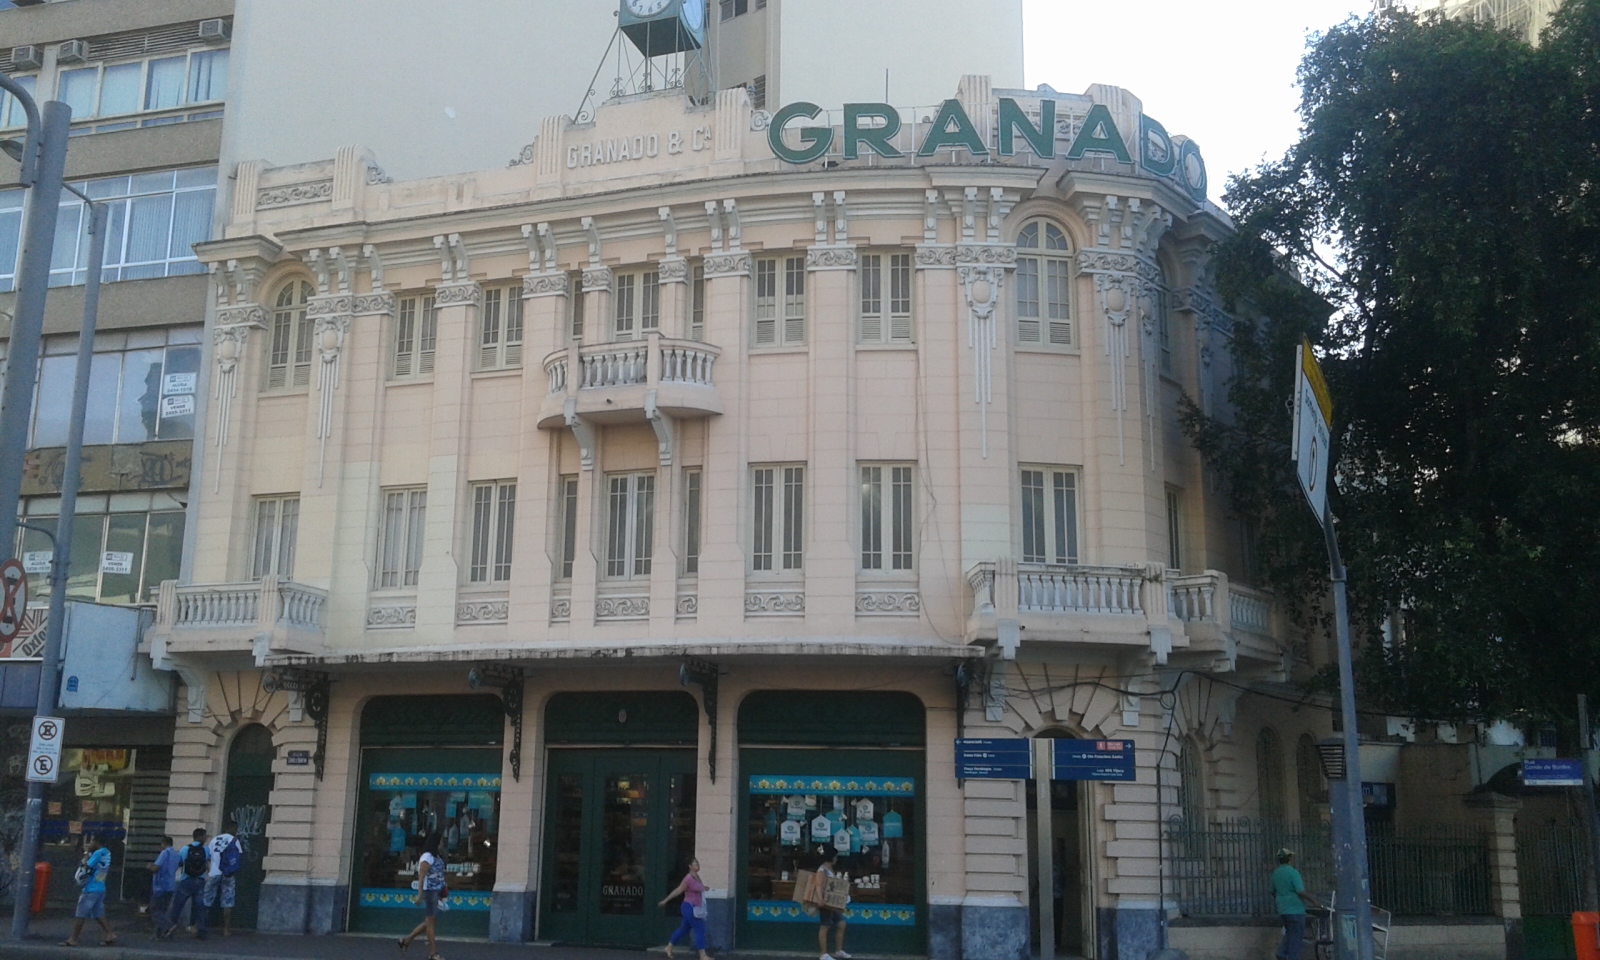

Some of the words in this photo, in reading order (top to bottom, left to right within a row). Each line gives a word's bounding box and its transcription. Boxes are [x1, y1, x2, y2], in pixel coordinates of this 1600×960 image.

[566, 132, 659, 169] GRANADO
[668, 130, 683, 155] &
[766, 97, 1207, 202] GRANADO
[602, 885, 643, 896] GRANADO
